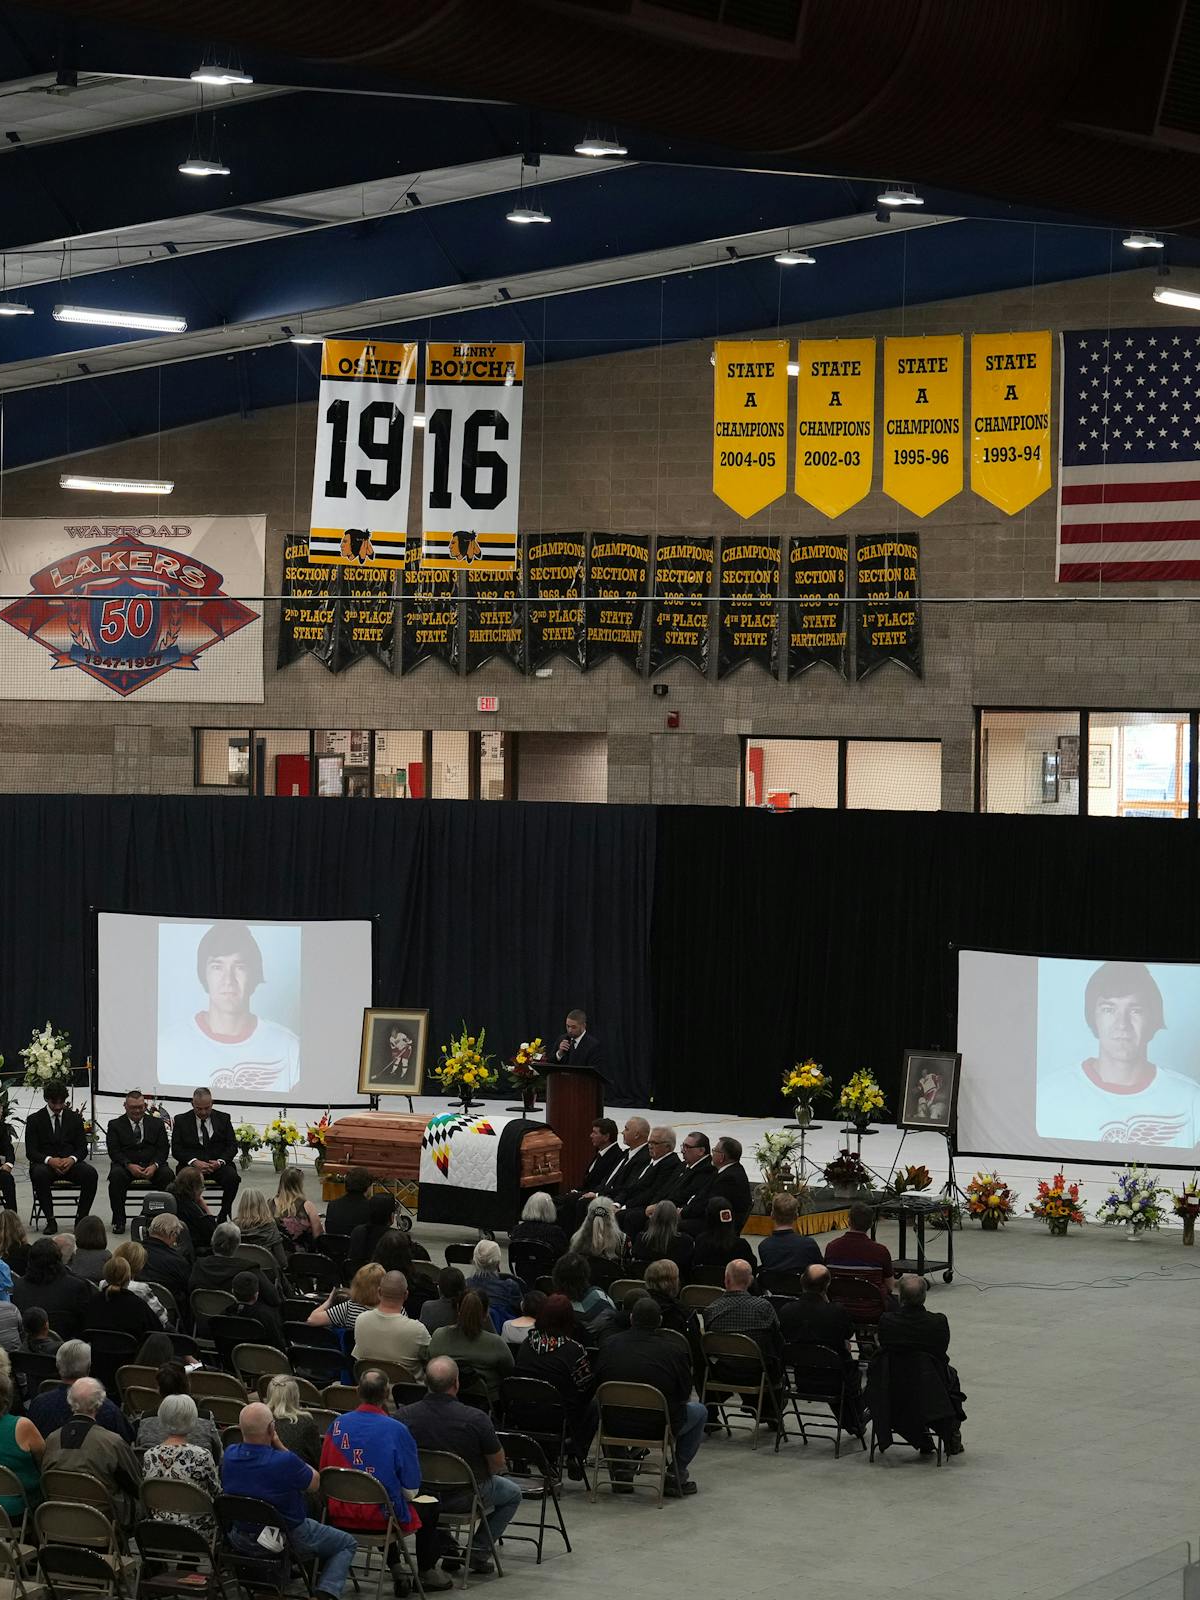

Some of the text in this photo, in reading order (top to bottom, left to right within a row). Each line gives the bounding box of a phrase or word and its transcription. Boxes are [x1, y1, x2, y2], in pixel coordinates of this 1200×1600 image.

[811, 360, 861, 377] STATE
[897, 357, 948, 374] STATE
[985, 353, 1037, 371] STATE
[727, 362, 775, 379] STATE
[828, 391, 842, 406] A
[915, 388, 929, 404] A
[1004, 384, 1019, 400] A
[744, 392, 757, 408] A
[716, 422, 784, 438] CHAMPIONS
[799, 420, 870, 437] CHAMPIONS
[886, 418, 959, 435] CHAMPIONS
[974, 413, 1049, 433] CHAMPIONS
[324, 399, 404, 501] 19
[894, 449, 949, 465] 1995-96
[983, 445, 1041, 463] 1993-94
[428, 408, 509, 510] 16
[720, 451, 776, 467] 2004-05
[804, 450, 861, 467] 2002-03
[64, 525, 192, 538] WARROAD
[529, 542, 585, 560] CHAMPIONS
[591, 543, 649, 562] CHAMPIONS
[656, 545, 714, 563] CHAMPIONS
[722, 545, 781, 563] CHAMPIONS
[790, 545, 848, 563] CHAMPIONS
[857, 543, 917, 562] CHAMPIONS
[50, 551, 207, 589] LAKERS
[286, 567, 337, 581] SECTION 8
[343, 568, 396, 582] SECTION 8
[405, 570, 451, 583] SECTION
[469, 570, 513, 582] SECTION
[530, 566, 577, 580] SECTION
[591, 566, 646, 582] SECTION 8
[656, 569, 712, 583] SECTION 8
[722, 570, 779, 583] SECTION 8
[795, 570, 845, 584] SECTION 8
[858, 567, 916, 583] SECTION 8A
[100, 594, 153, 644] 50
[300, 610, 333, 623] PLACE
[359, 611, 393, 624] PLACE
[422, 612, 457, 625] PLACE
[480, 612, 512, 624] STATE
[549, 609, 584, 623] PLACE
[600, 611, 633, 625] STATE
[672, 614, 708, 627] PLACE
[740, 614, 777, 628] PLACE
[803, 614, 837, 628] STATE
[877, 612, 915, 627] PLACE
[293, 627, 324, 640] STATE
[352, 628, 383, 641] STATE
[416, 630, 447, 643] STATE
[469, 629, 522, 642] PARTICIPANT
[543, 627, 574, 640] STATE
[587, 628, 642, 643] PARTICIPANT
[665, 631, 698, 645] STATE
[734, 632, 767, 646] STATE
[791, 632, 846, 647] PARTICIPANT
[871, 631, 906, 646] STATE
